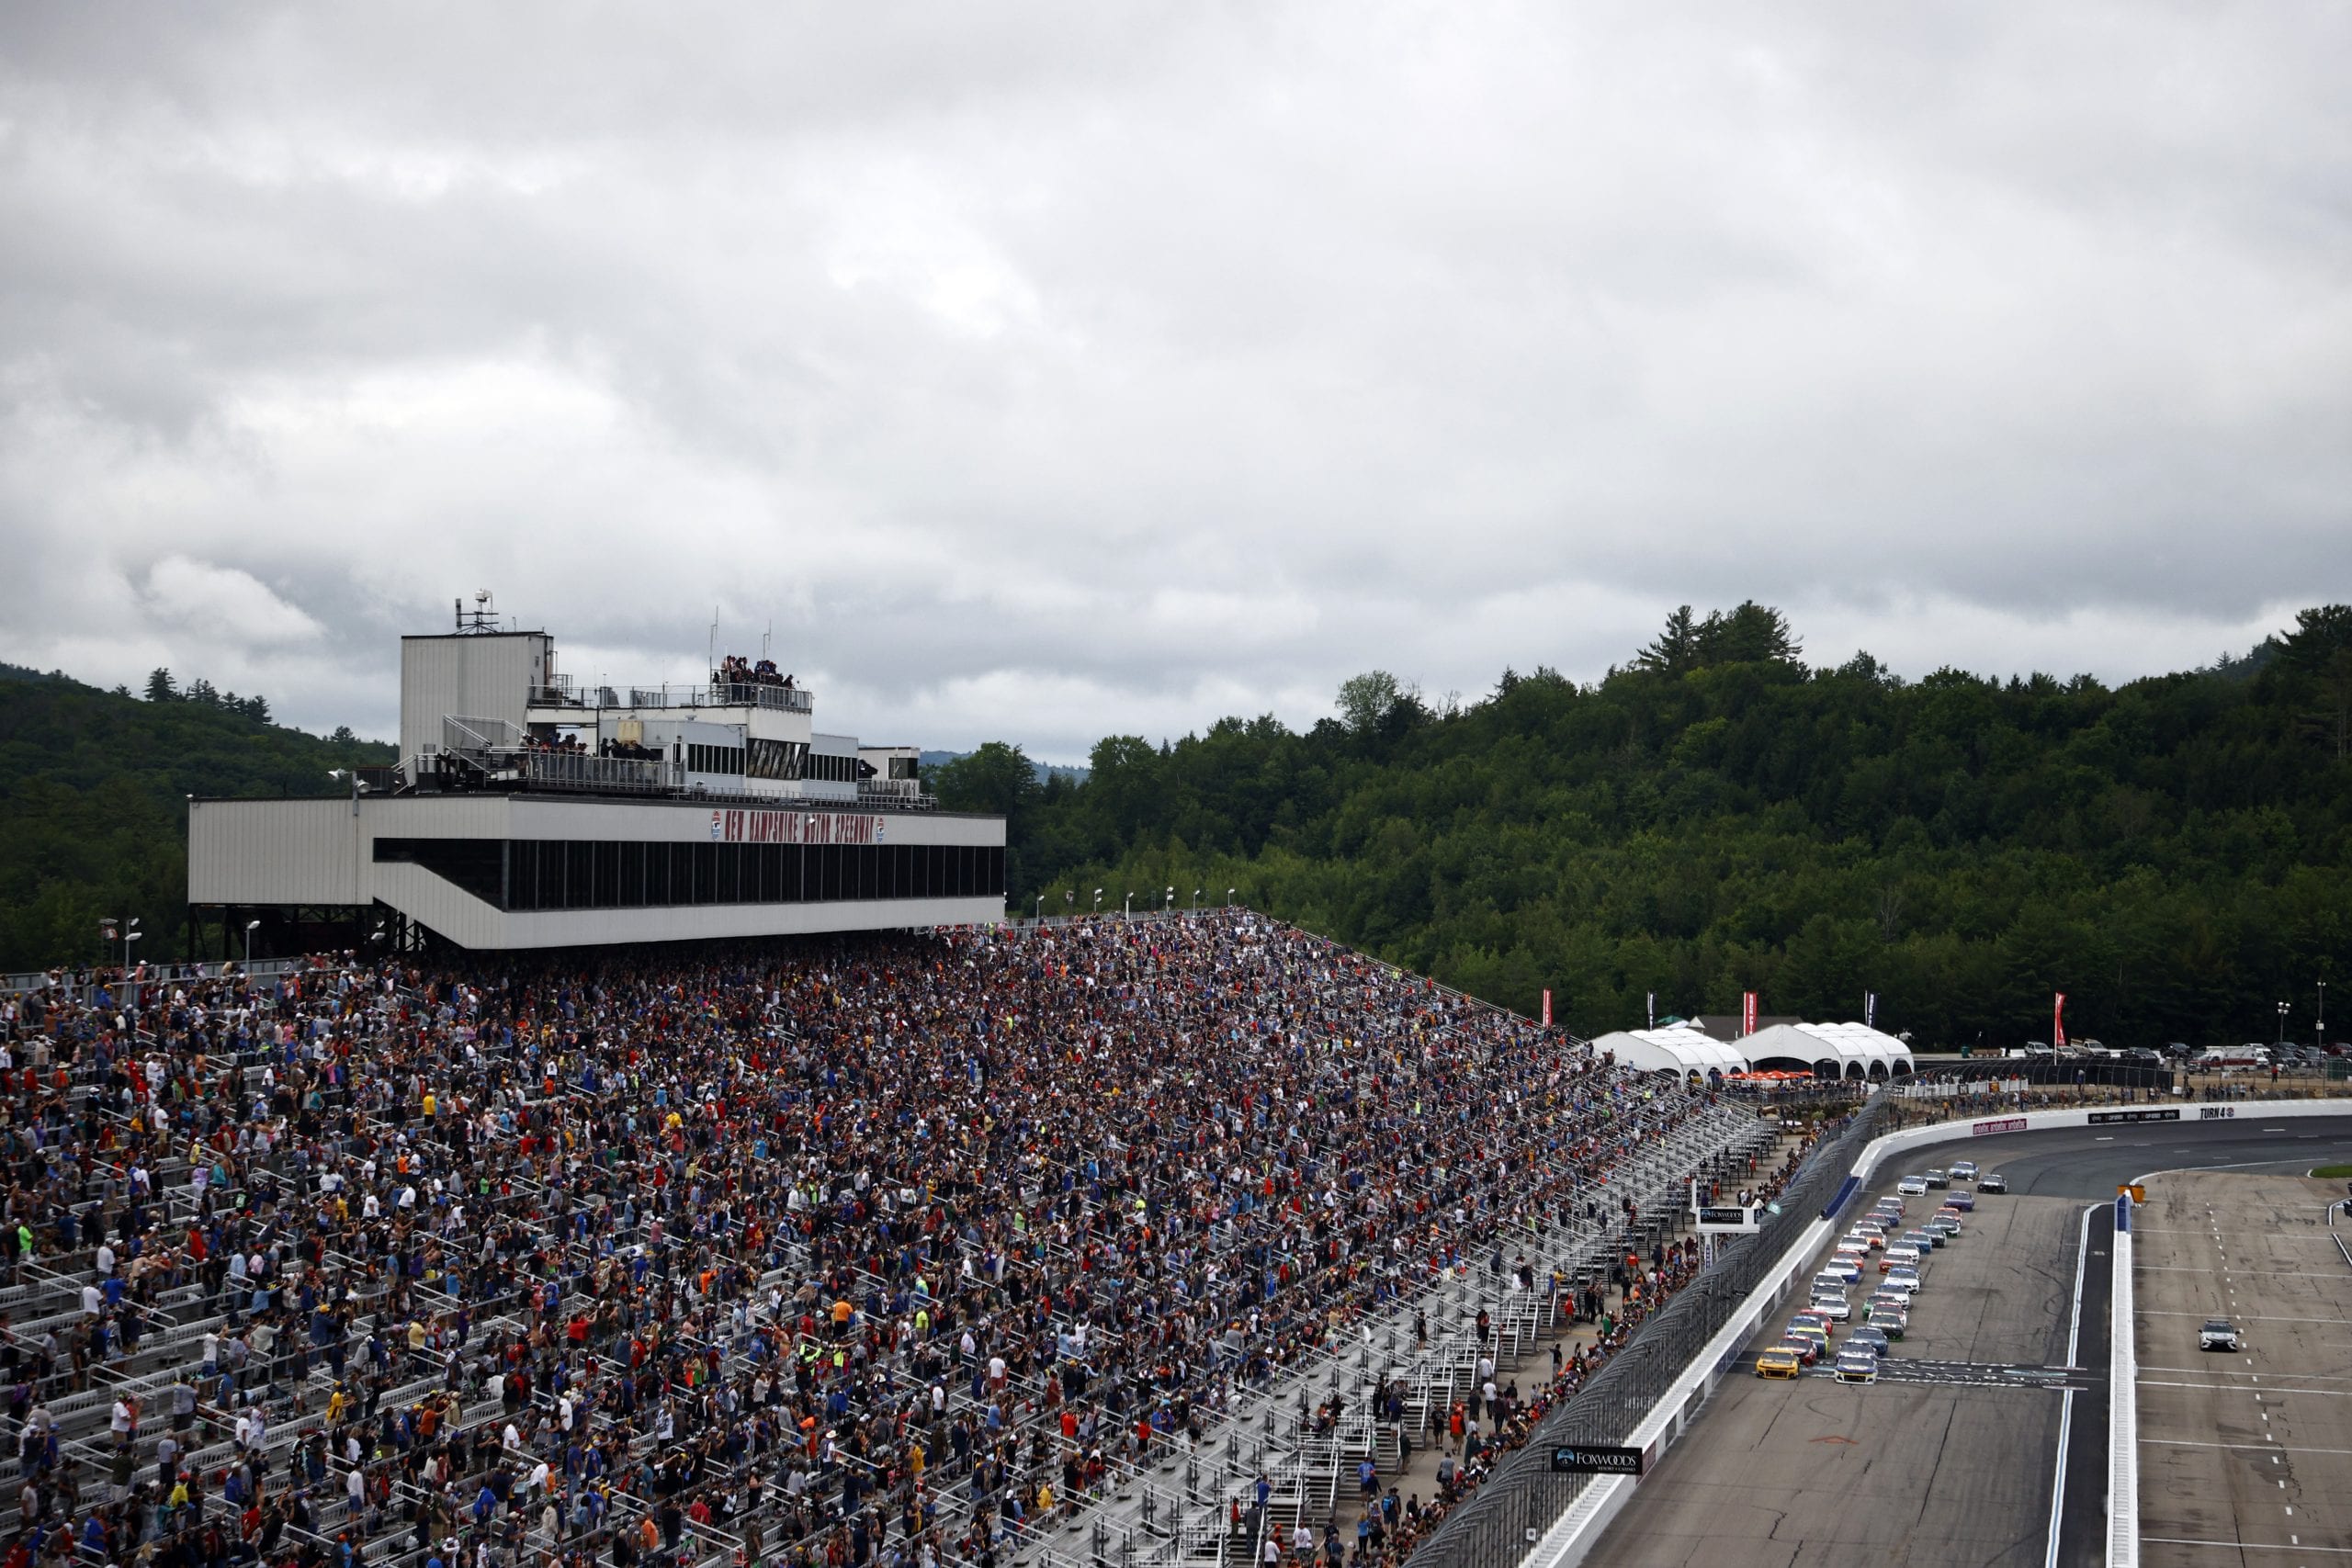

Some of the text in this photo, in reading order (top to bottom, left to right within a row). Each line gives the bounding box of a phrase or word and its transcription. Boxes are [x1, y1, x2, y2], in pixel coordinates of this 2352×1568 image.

[725, 809, 745, 841] NEW
[749, 810, 798, 842] HAMPSHIRE
[834, 814, 875, 844] SPEEDWAY
[2200, 1107, 2225, 1119] TURN 4
[1577, 1452, 1636, 1466] FOXWOODS
